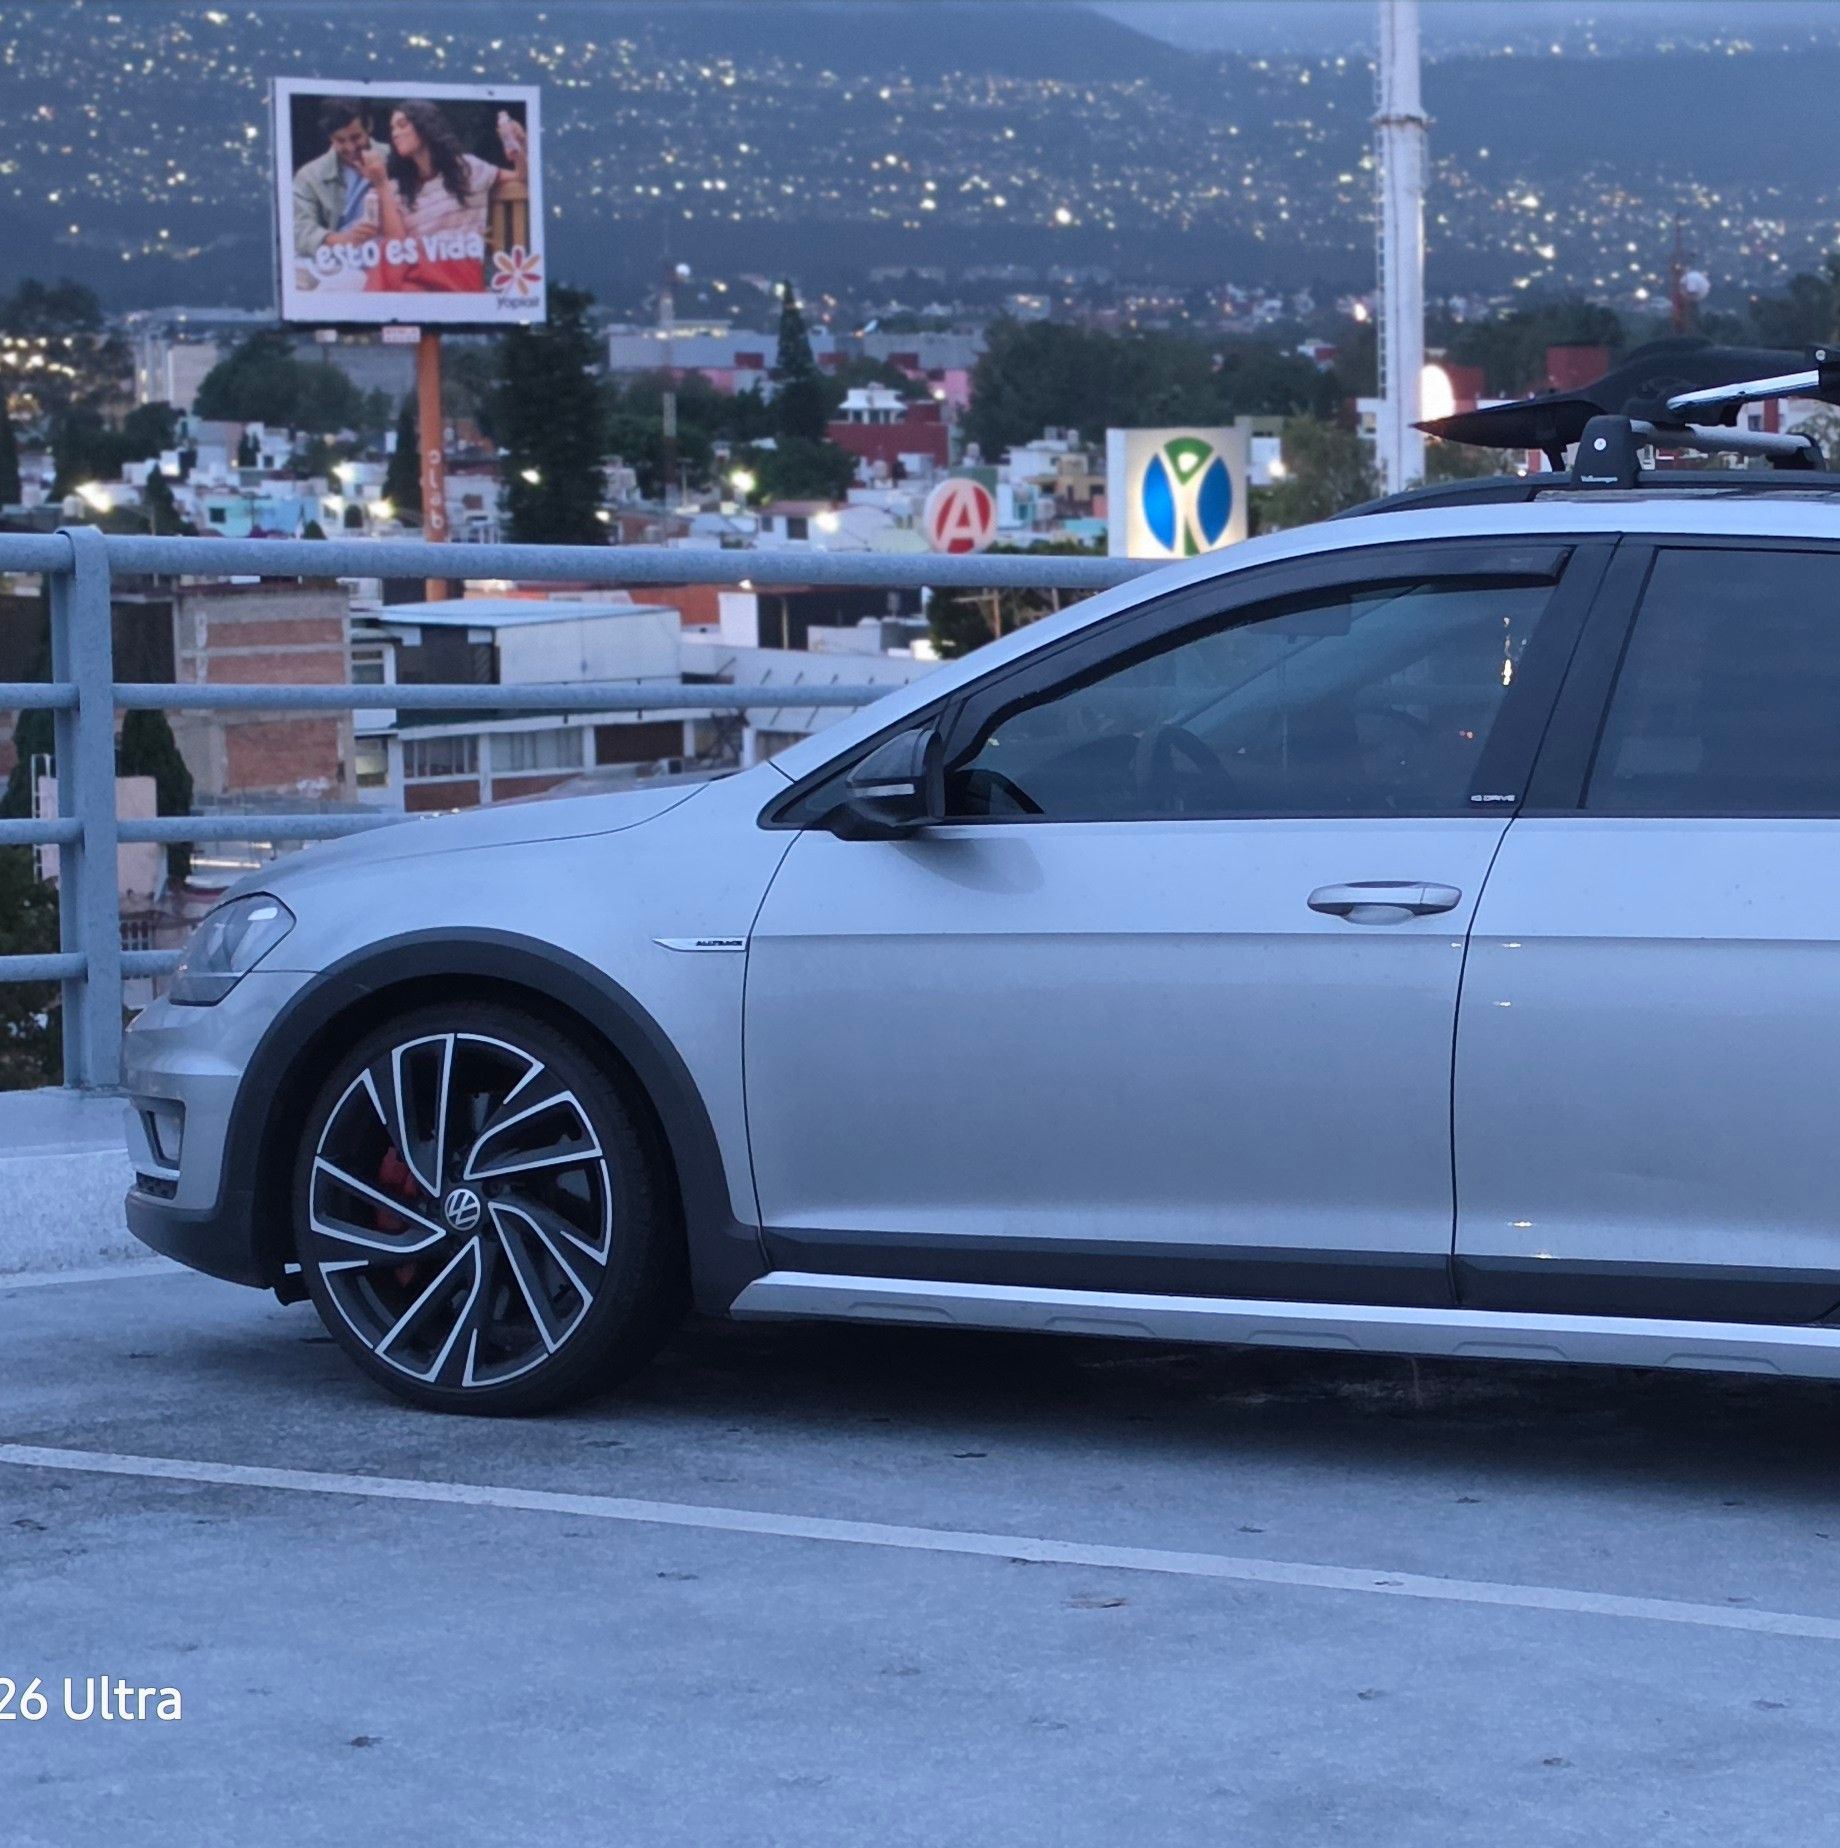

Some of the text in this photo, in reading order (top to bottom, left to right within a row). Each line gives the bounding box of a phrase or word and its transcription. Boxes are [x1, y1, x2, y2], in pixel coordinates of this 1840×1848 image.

[316, 240, 380, 270] esto
[385, 238, 418, 265] es
[935, 480, 989, 554] A
